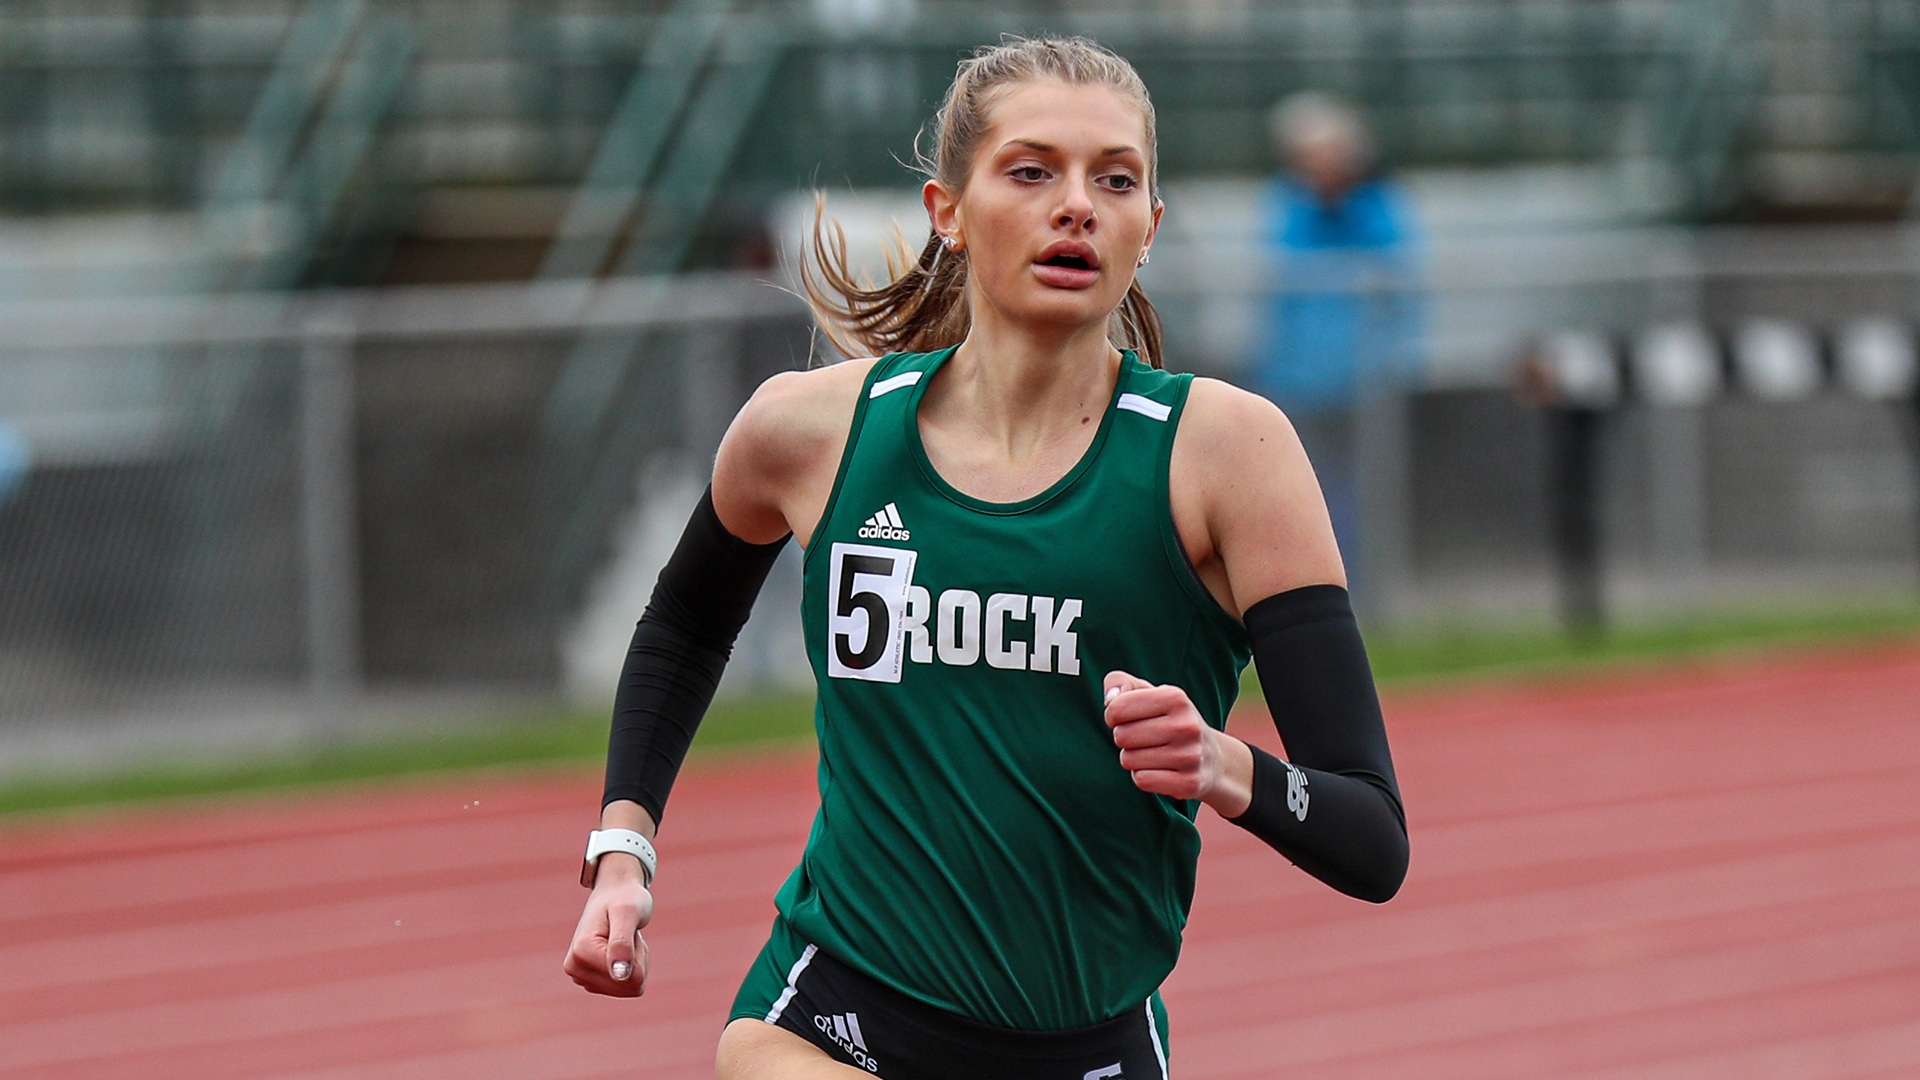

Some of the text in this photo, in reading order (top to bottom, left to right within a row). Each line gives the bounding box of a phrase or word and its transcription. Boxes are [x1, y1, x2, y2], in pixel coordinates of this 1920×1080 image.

[858, 525, 910, 541] adidas
[834, 553, 896, 670] 5
[904, 585, 1083, 676] ROCK
[814, 1014, 878, 1073] adidas
